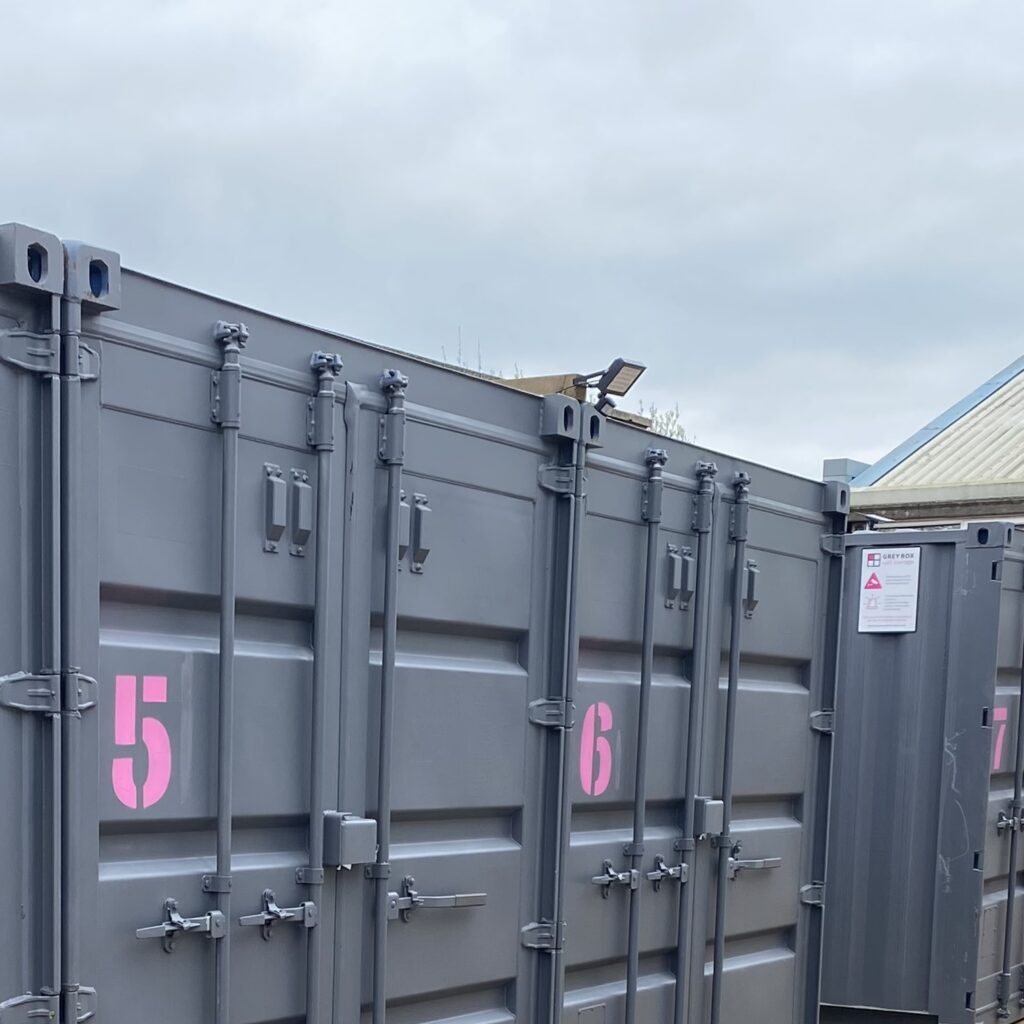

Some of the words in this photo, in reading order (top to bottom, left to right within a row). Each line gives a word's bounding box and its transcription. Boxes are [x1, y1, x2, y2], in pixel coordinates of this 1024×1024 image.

[112, 675, 172, 809] 5
[579, 702, 613, 796] 6
[993, 707, 1007, 770] 7
